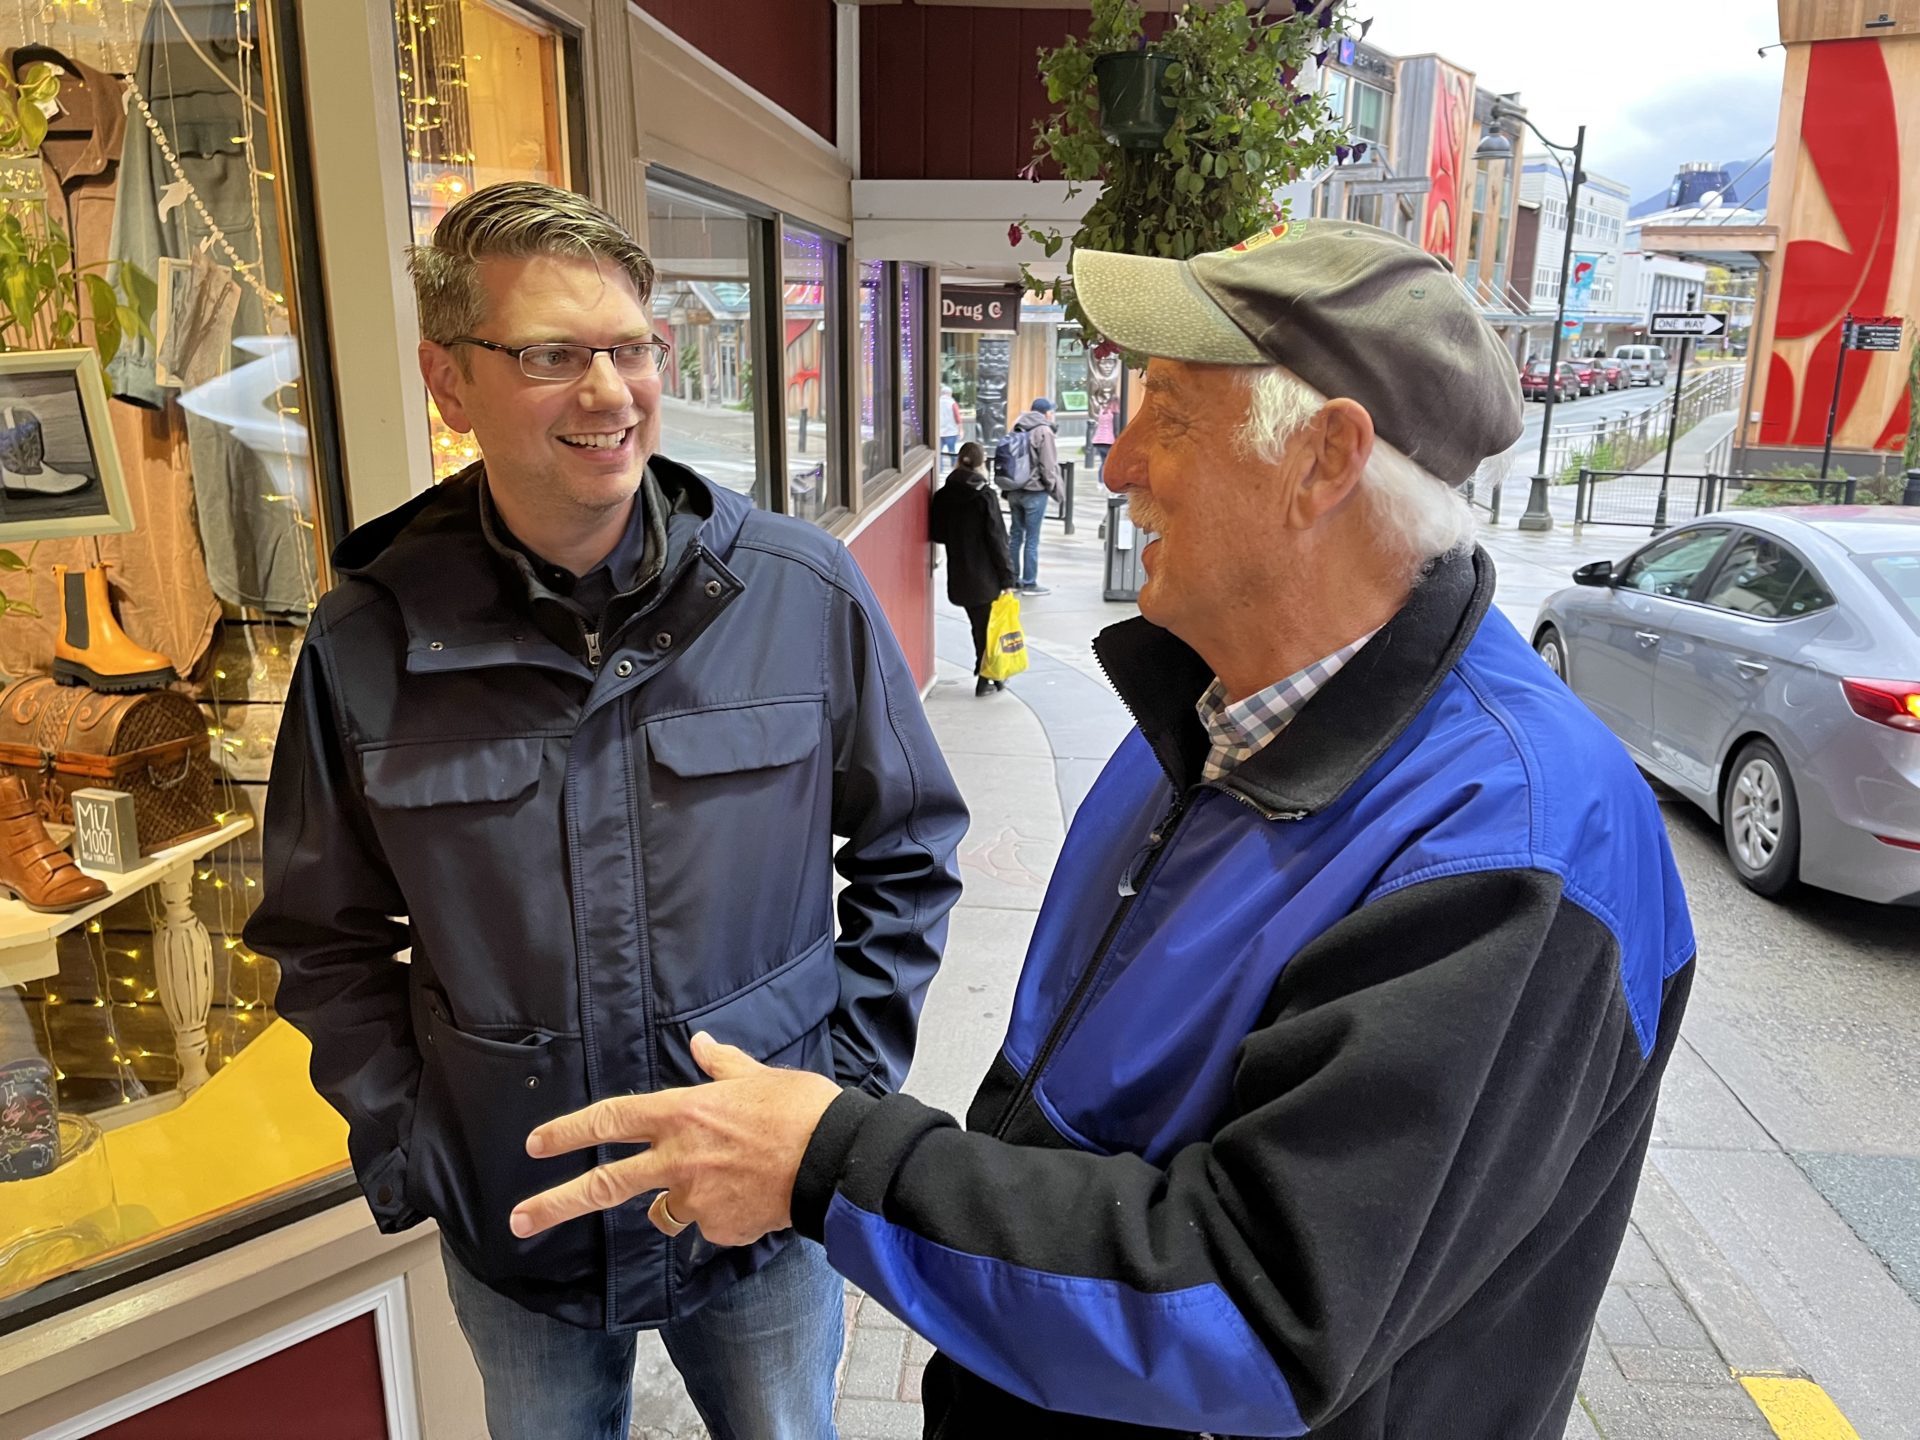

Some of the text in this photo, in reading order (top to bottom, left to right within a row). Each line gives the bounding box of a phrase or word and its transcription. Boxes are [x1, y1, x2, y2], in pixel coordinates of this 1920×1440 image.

[942, 299, 983, 321] Drug
[1658, 319, 1705, 329] ONE WAY
[80, 828, 114, 857] MOOZ
